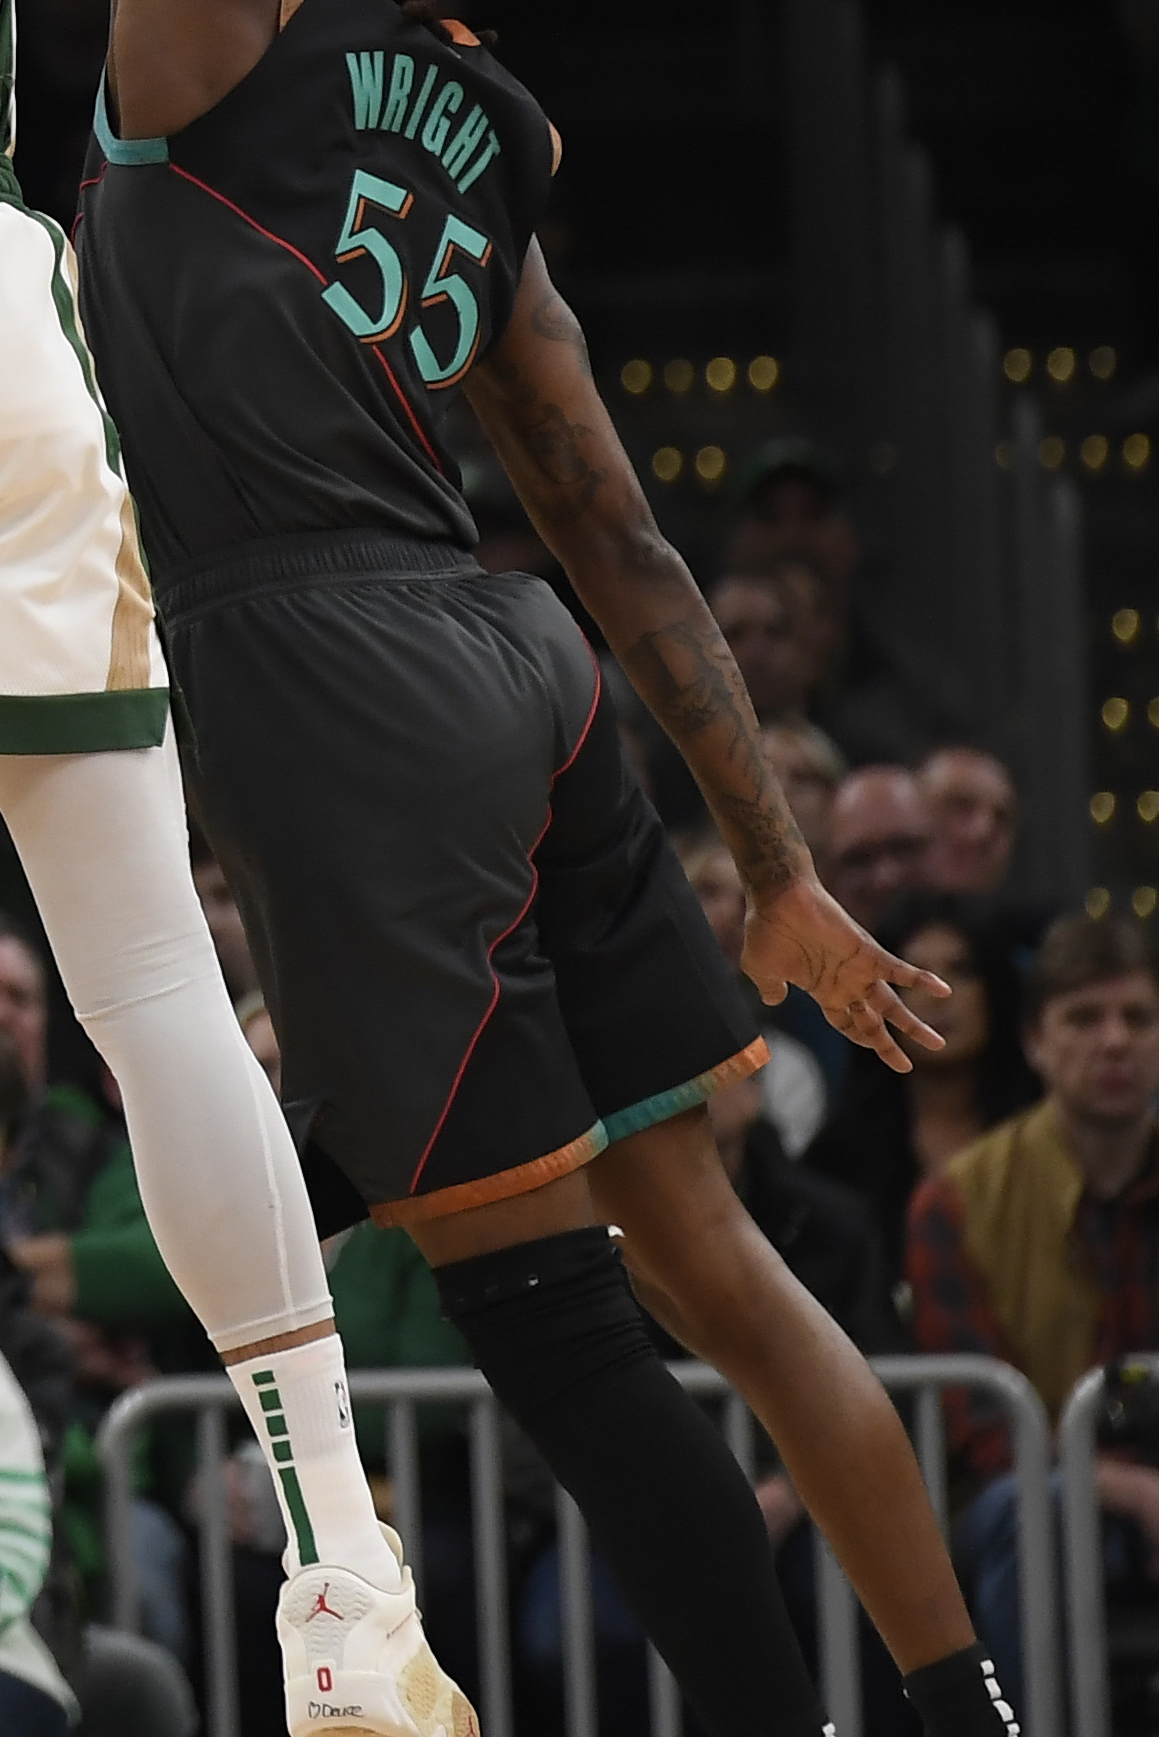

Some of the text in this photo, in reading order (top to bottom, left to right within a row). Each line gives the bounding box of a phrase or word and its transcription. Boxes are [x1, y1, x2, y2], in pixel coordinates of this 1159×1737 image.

[345, 50, 501, 194] WRIGHT
[321, 168, 493, 390] 55
[317, 1667, 333, 1692] 0
